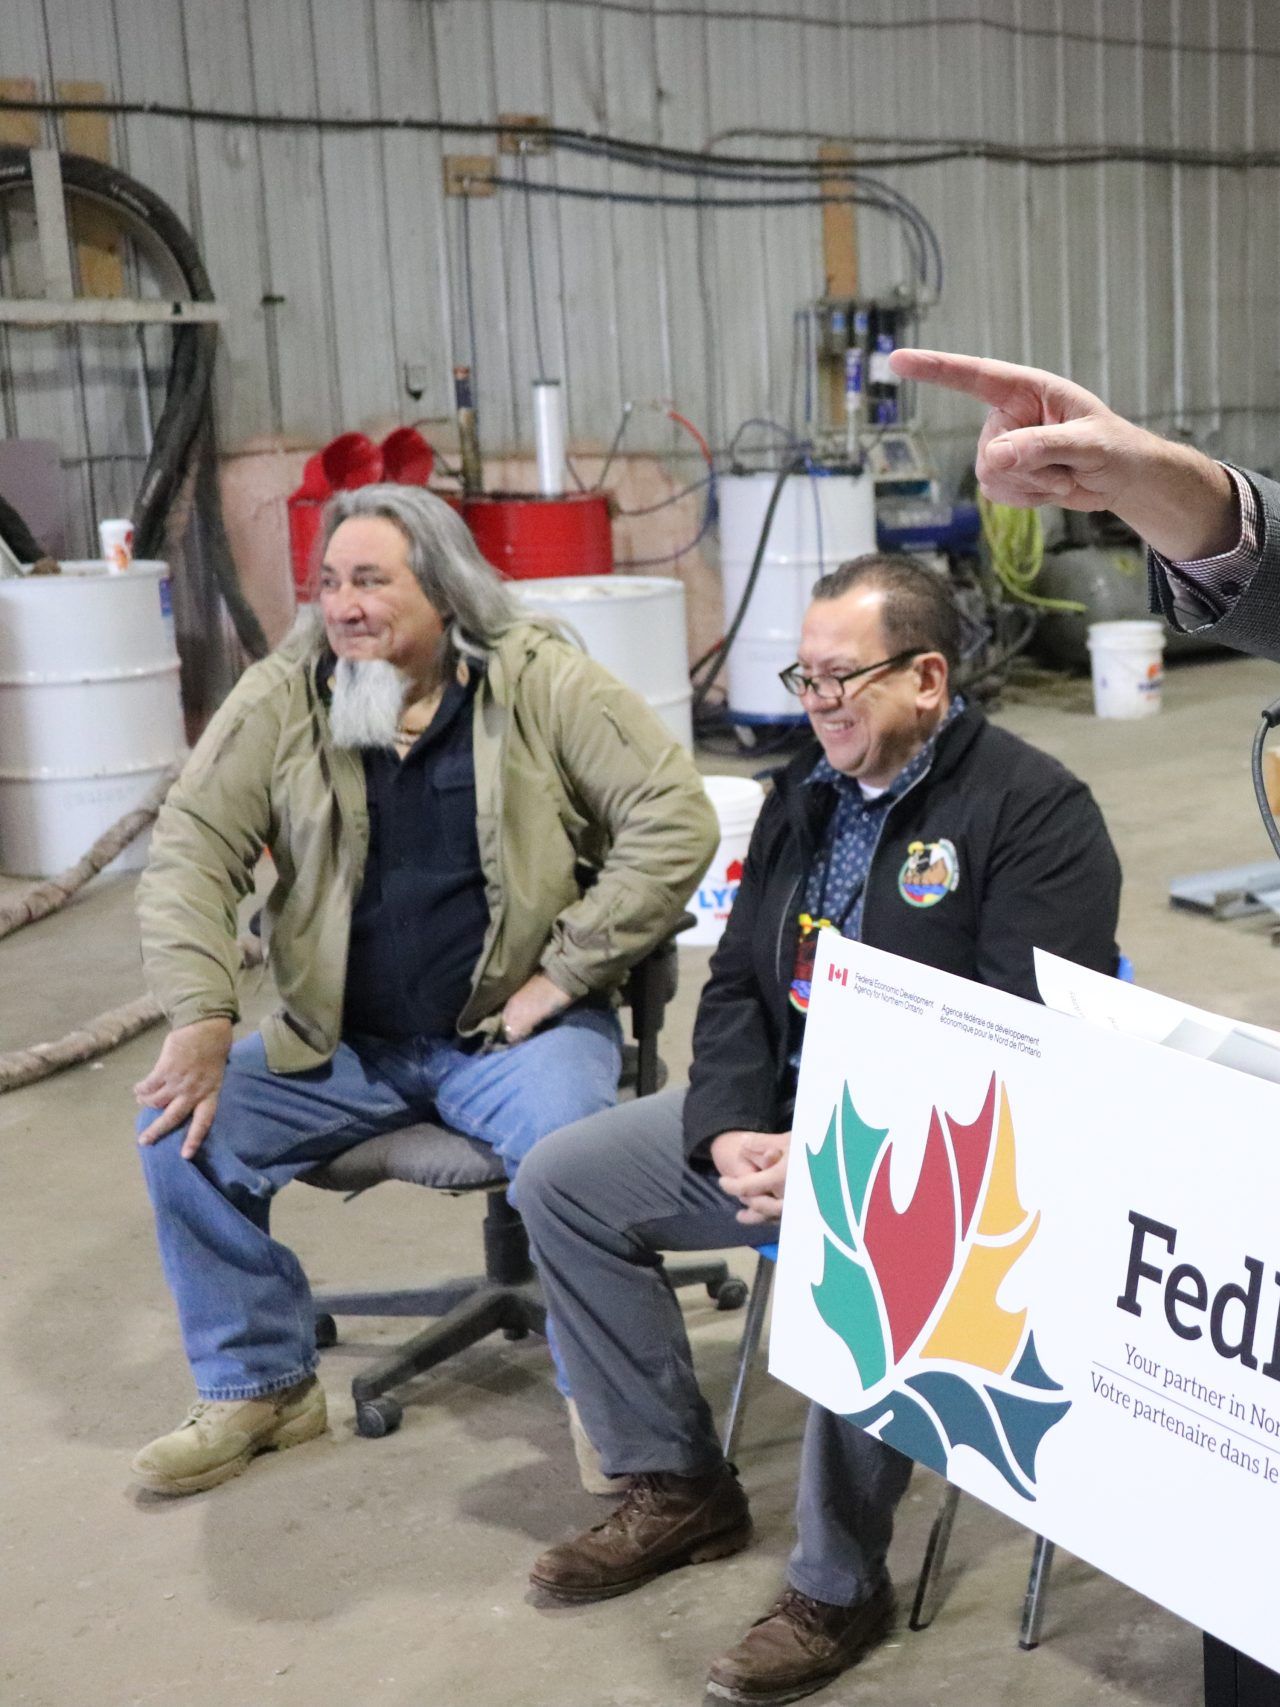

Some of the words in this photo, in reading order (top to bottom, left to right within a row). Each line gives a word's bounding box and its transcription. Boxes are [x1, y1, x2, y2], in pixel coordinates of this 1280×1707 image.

[854, 982, 873, 998] Agency
[873, 989, 881, 999] for
[881, 992, 904, 1007] Northern
[904, 1000, 924, 1016] Ontario
[855, 972, 874, 986] Federal
[874, 979, 900, 996] Economic
[900, 988, 935, 1008] Development
[941, 1003, 963, 1018] Agence
[963, 1011, 986, 1027] fédérale
[986, 1019, 994, 1029] de
[994, 1023, 1040, 1046] développement
[973, 1027, 988, 1038] pour
[988, 1031, 994, 1040] le
[994, 1033, 1009, 1046] Nord
[1009, 1040, 1017, 1049] de
[1124, 1343, 1161, 1378] Your
[1163, 1364, 1225, 1410] partner
[1230, 1394, 1246, 1421] in
[1090, 1371, 1131, 1410] Votre
[1132, 1394, 1217, 1451] partenaire
[1220, 1437, 1260, 1474] dans
[1263, 1456, 1279, 1484] le
